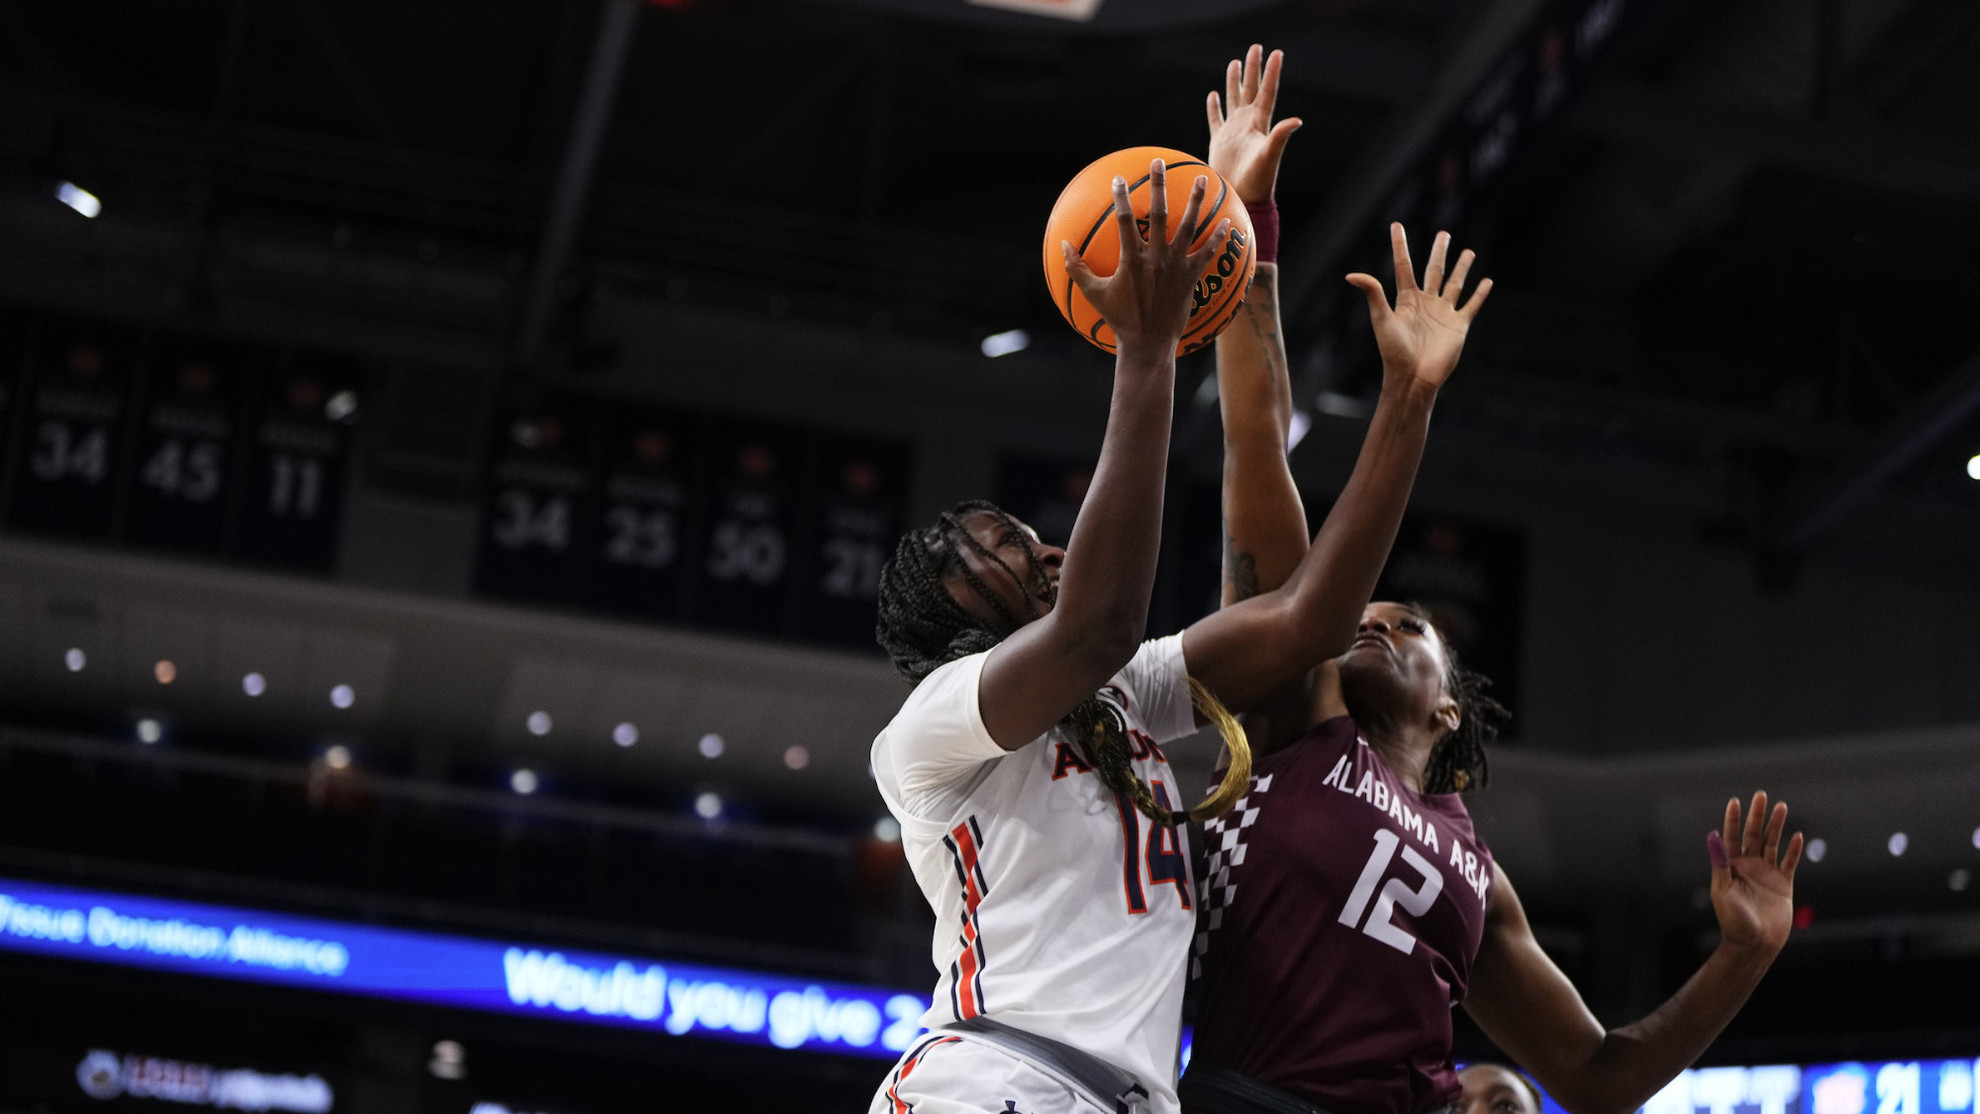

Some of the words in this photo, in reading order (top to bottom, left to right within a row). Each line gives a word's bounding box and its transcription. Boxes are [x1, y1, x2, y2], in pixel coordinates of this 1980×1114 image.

[30, 417, 110, 485] 34
[142, 437, 223, 502] 45
[267, 450, 325, 520] 11
[492, 486, 575, 554] 34
[603, 503, 679, 570] 25
[705, 518, 789, 588] 50
[1322, 754, 1440, 855] ALABAMA
[1113, 779, 1191, 914] 14
[1337, 828, 1444, 956] 12
[88, 906, 227, 961] Donation
[227, 925, 349, 976] Alliance
[504, 947, 667, 1021] Would
[664, 977, 768, 1036] you
[768, 986, 882, 1050] give
